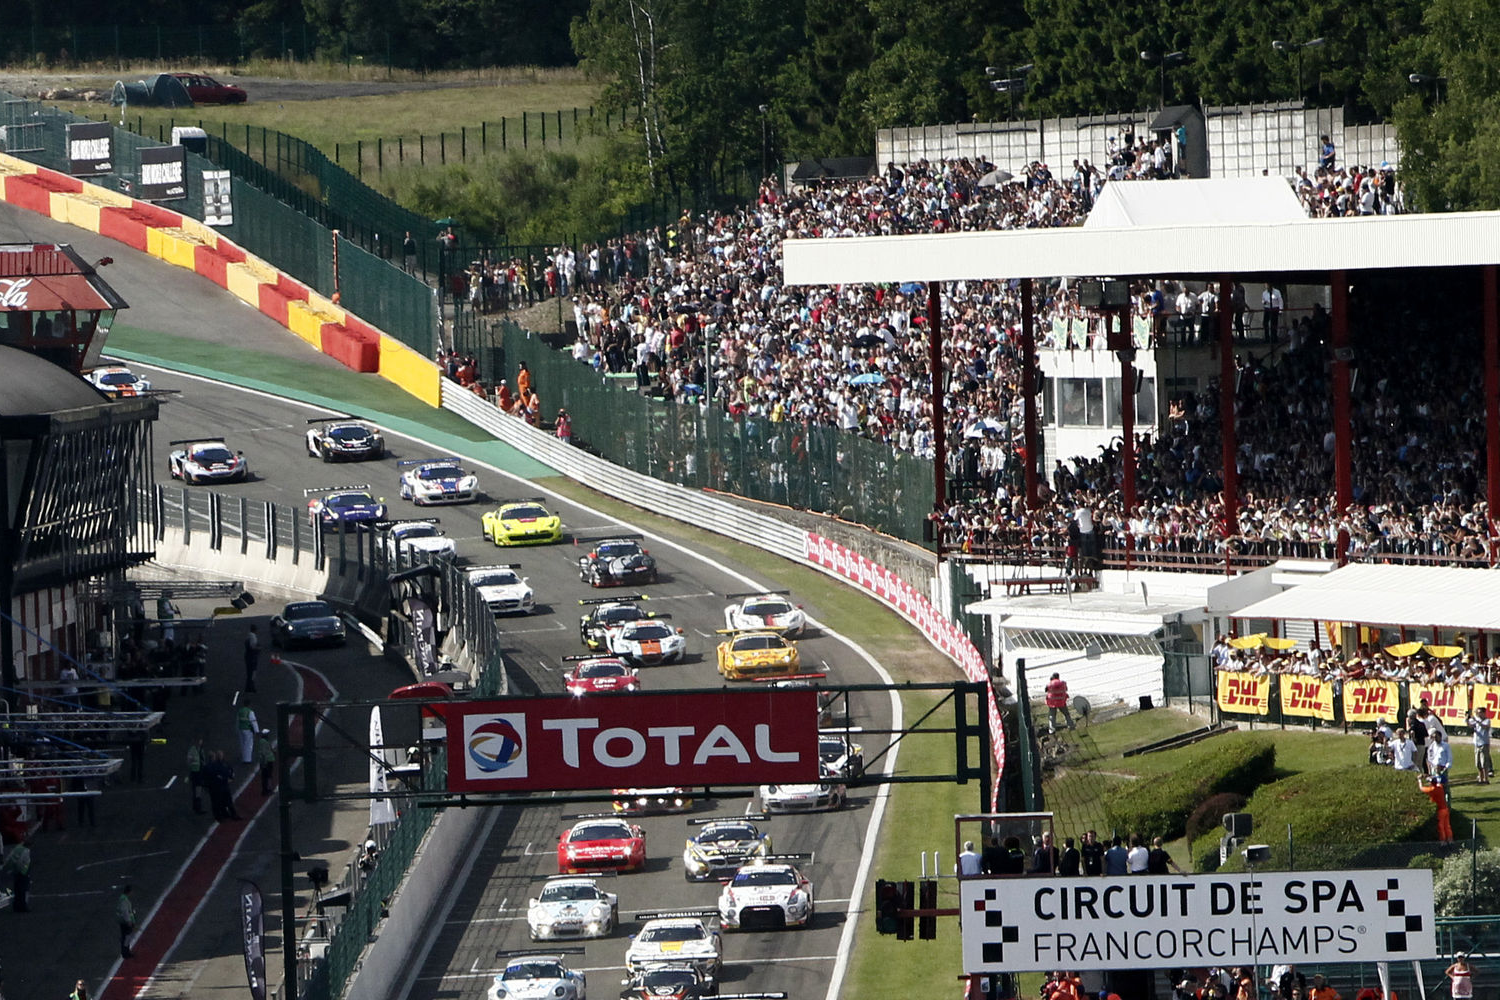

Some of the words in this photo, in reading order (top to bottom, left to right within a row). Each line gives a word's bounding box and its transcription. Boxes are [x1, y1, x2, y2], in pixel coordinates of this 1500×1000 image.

[1227, 679, 1260, 706] DHL
[1289, 682, 1322, 711] DHL
[1353, 687, 1388, 714] DHL
[542, 717, 800, 768] TOTAL
[1034, 883, 1195, 920] CIRCUIT
[1210, 881, 1263, 916] DE
[1284, 879, 1365, 914] SPA
